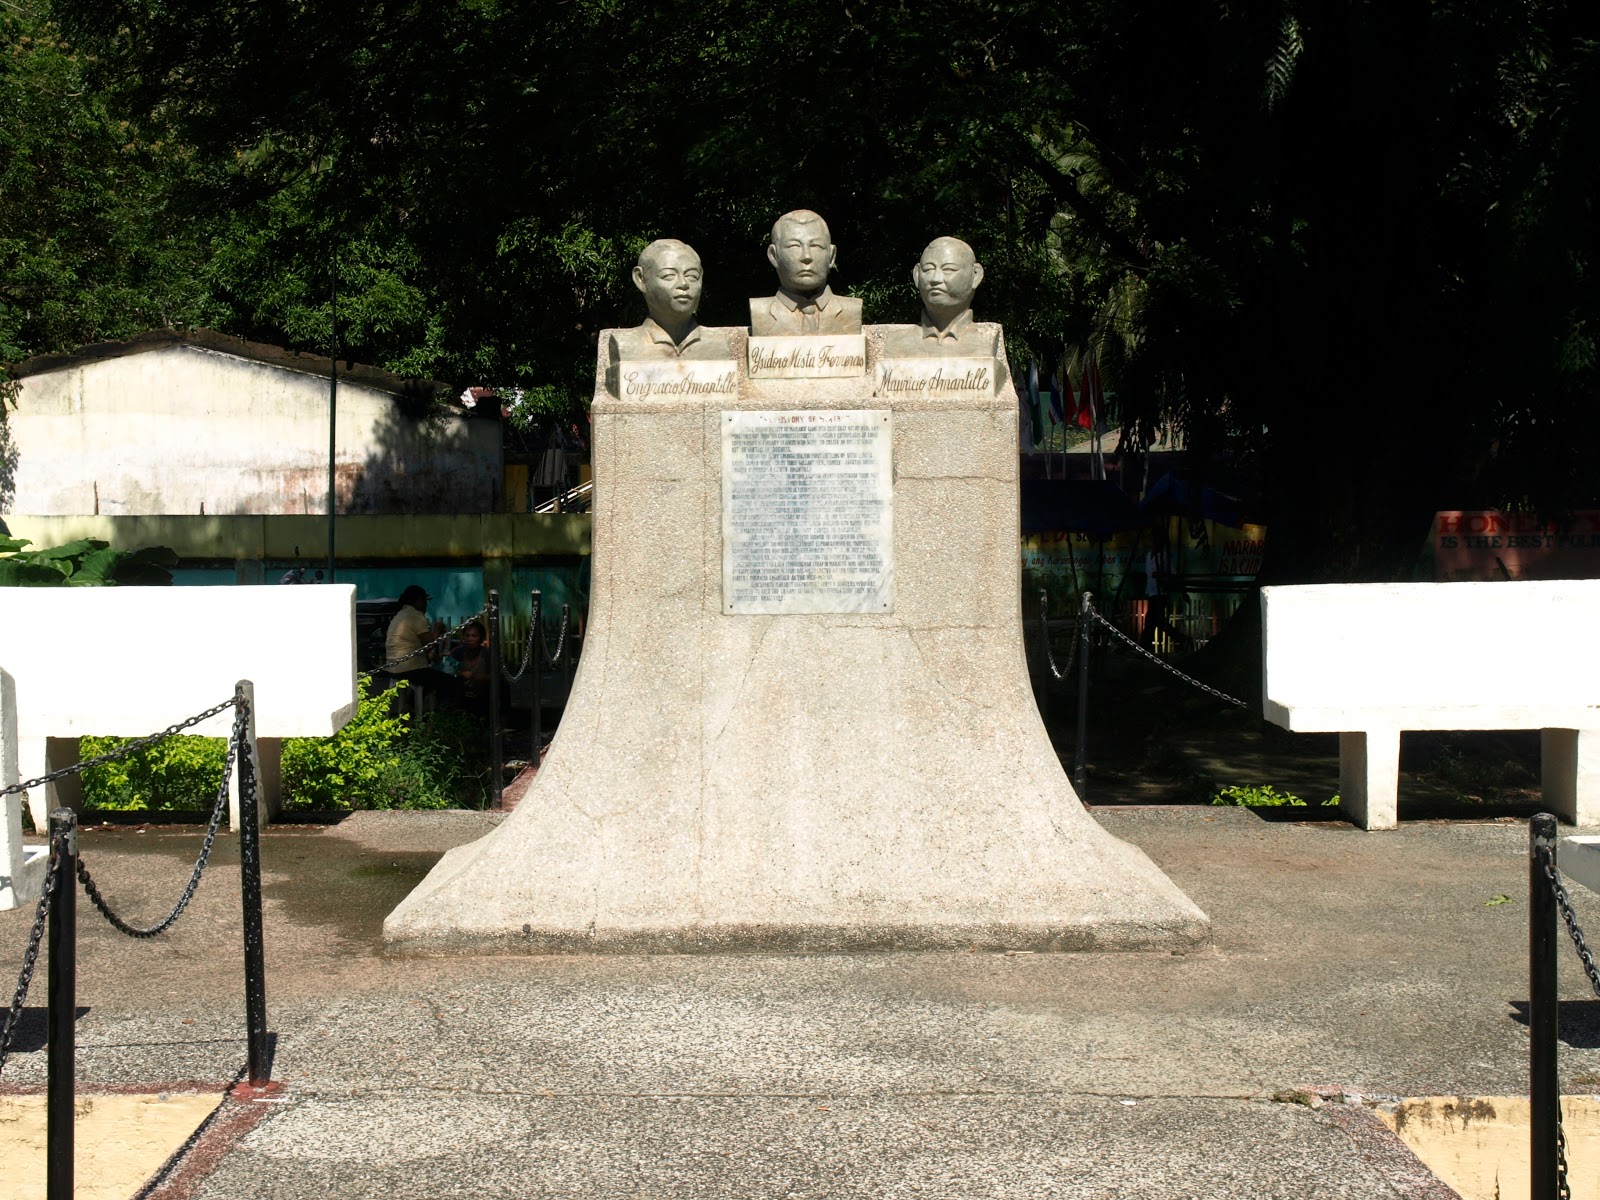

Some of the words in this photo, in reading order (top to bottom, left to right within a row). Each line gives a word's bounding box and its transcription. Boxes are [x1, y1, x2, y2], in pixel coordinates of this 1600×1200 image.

[623, 371, 680, 401] Engracio
[679, 371, 737, 395] Amantillo
[876, 369, 926, 392] Mauricio
[928, 367, 990, 391] Amantillo
[1439, 513, 1600, 534] HONEY
[1440, 535, 1458, 549] IS
[1464, 535, 1502, 549] THE
[1507, 535, 1554, 549] BEST
